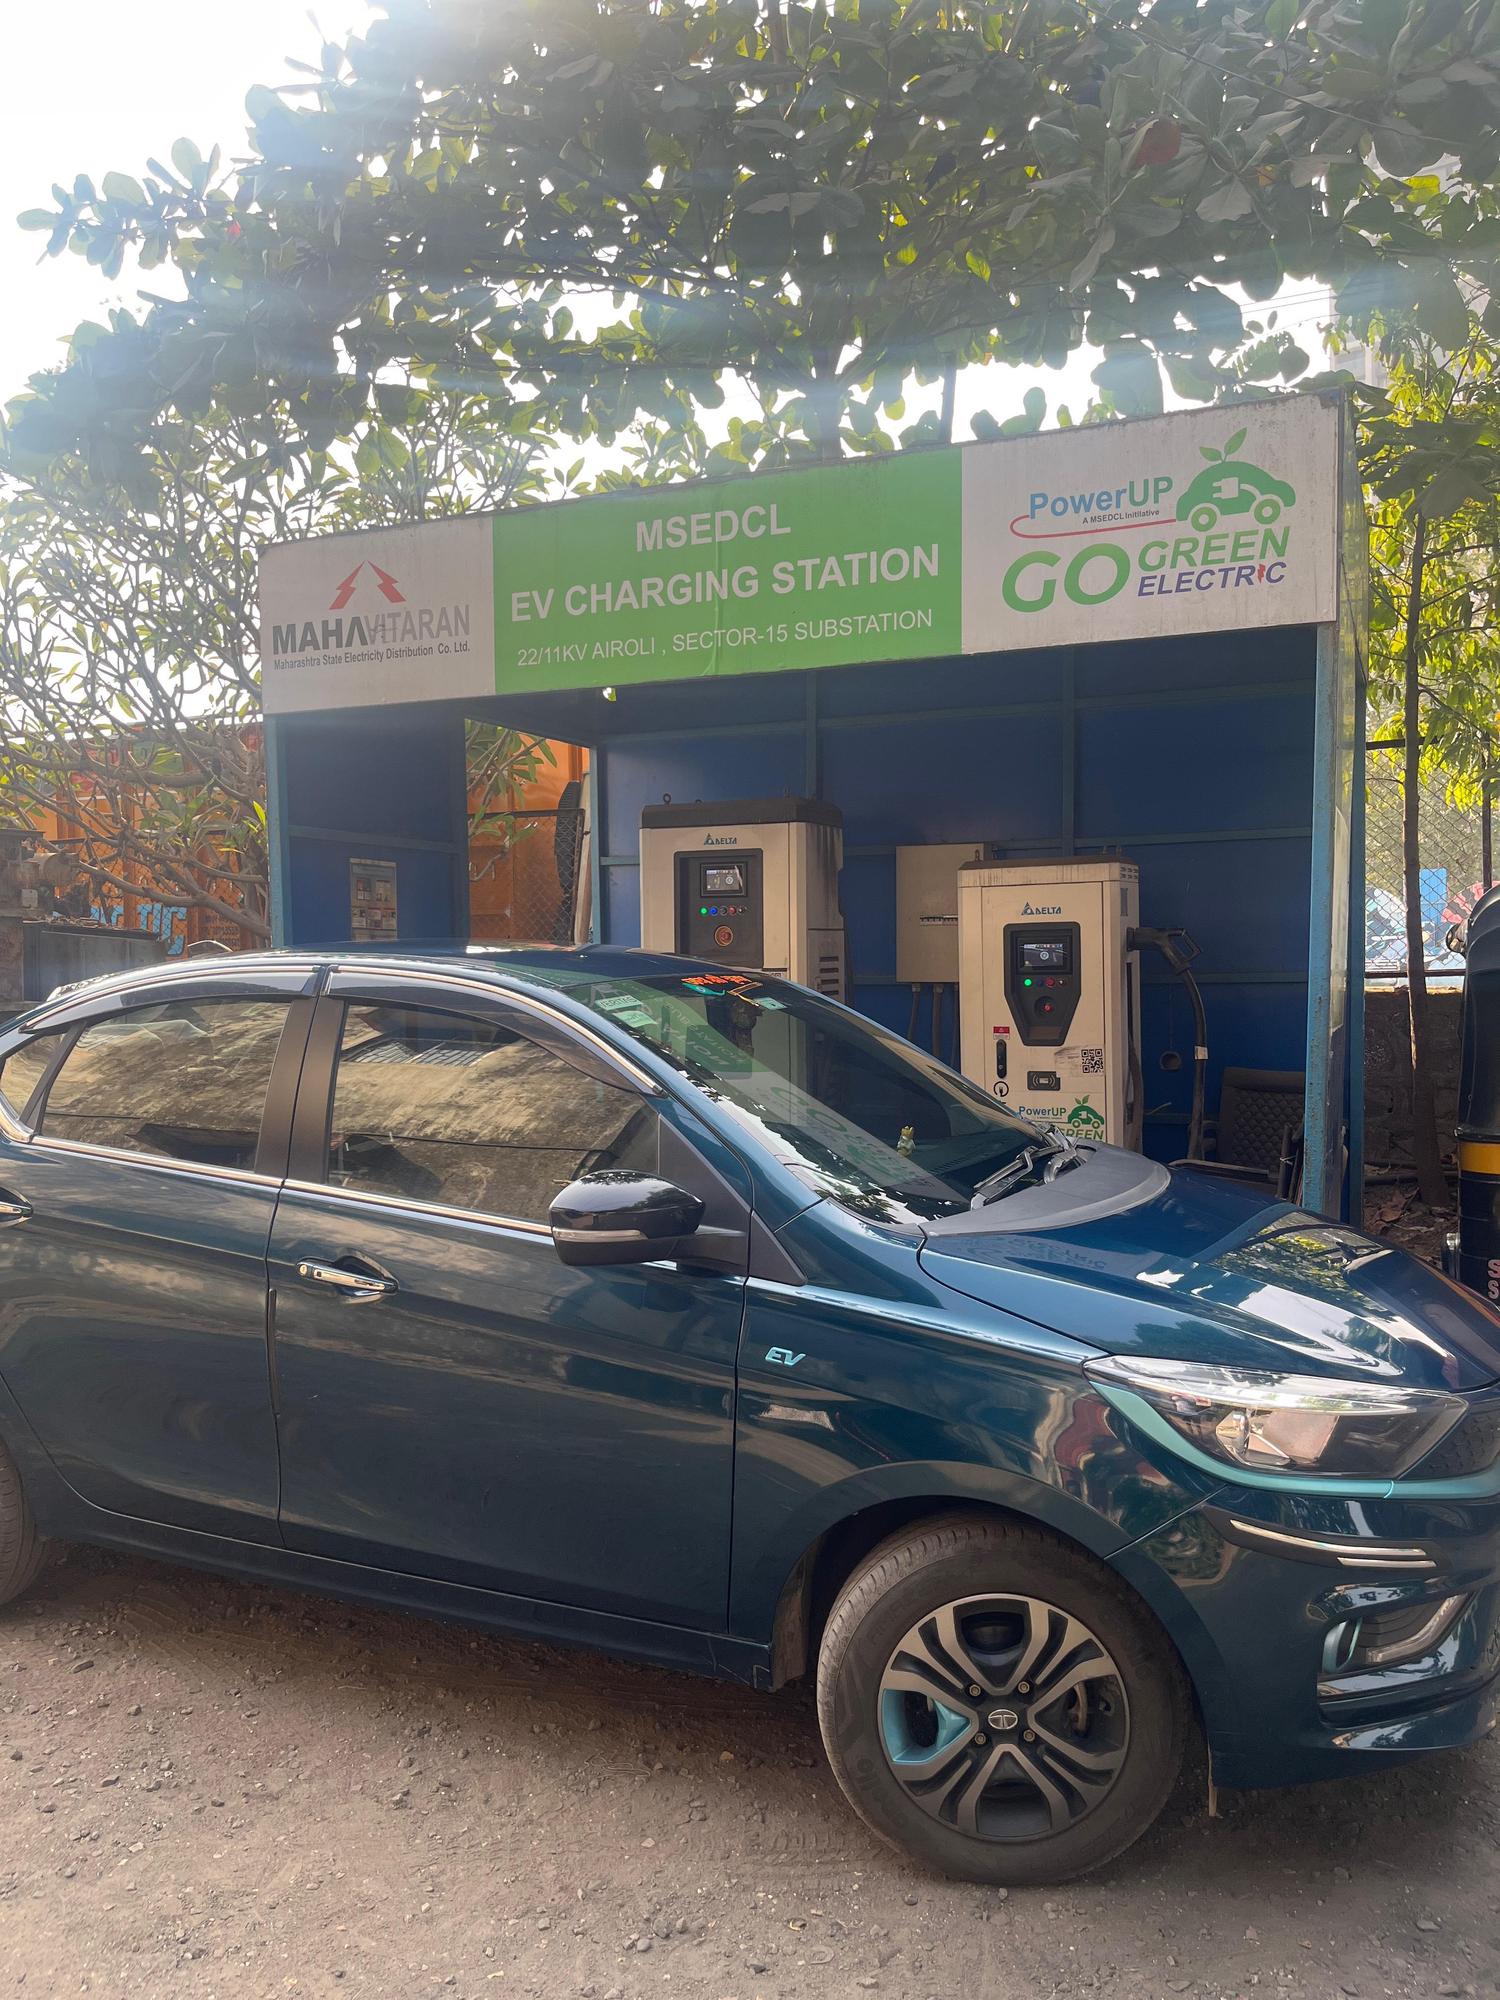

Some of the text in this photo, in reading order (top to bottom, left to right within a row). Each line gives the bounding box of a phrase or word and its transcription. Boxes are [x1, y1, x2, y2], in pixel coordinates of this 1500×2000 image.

[1029, 475, 1174, 519] PowerUP
[1090, 512, 1124, 523] MSEDCL
[635, 503, 791, 552] MSEDCL
[1137, 525, 1291, 573] GREEN
[510, 543, 939, 622] EV CHARGING STATION
[1001, 542, 1131, 614] GO
[272, 604, 471, 656] MAHAVITARAN
[517, 643, 587, 667] 22/11KV
[592, 637, 655, 660] AIROLI
[672, 625, 788, 652] SECTOR-15
[794, 608, 933, 641] SUBSTATION
[273, 640, 470, 671] Maharashtra State Electricity Distribution Co. Ltd.
[715, 836, 738, 845] DELTA
[1035, 905, 1062, 915] DELTA
[1018, 1105, 1067, 1119] PowerUP
[765, 1346, 806, 1366] EV
